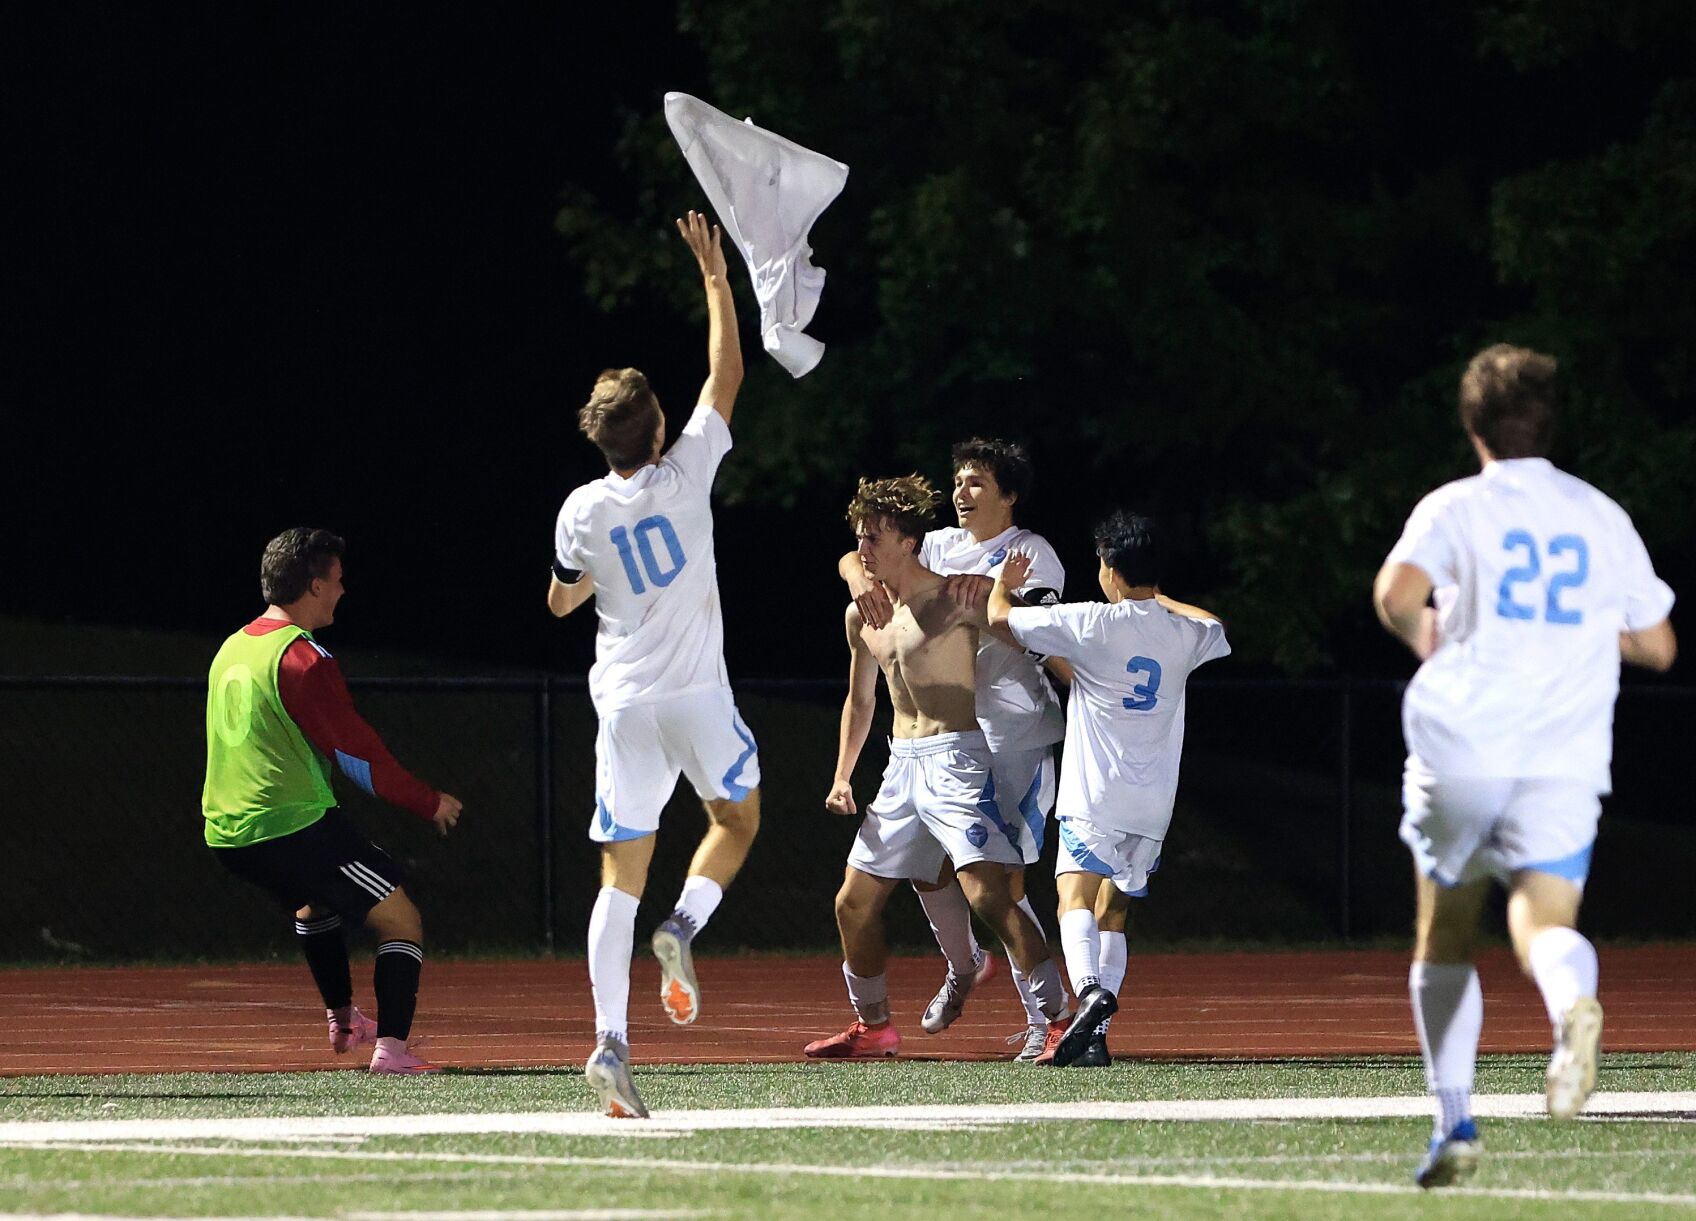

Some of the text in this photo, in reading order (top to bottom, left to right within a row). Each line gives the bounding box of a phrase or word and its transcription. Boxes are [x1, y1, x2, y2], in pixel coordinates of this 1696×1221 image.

[609, 514, 688, 594] 10
[1497, 528, 1588, 624] 22
[1122, 655, 1162, 711] 3
